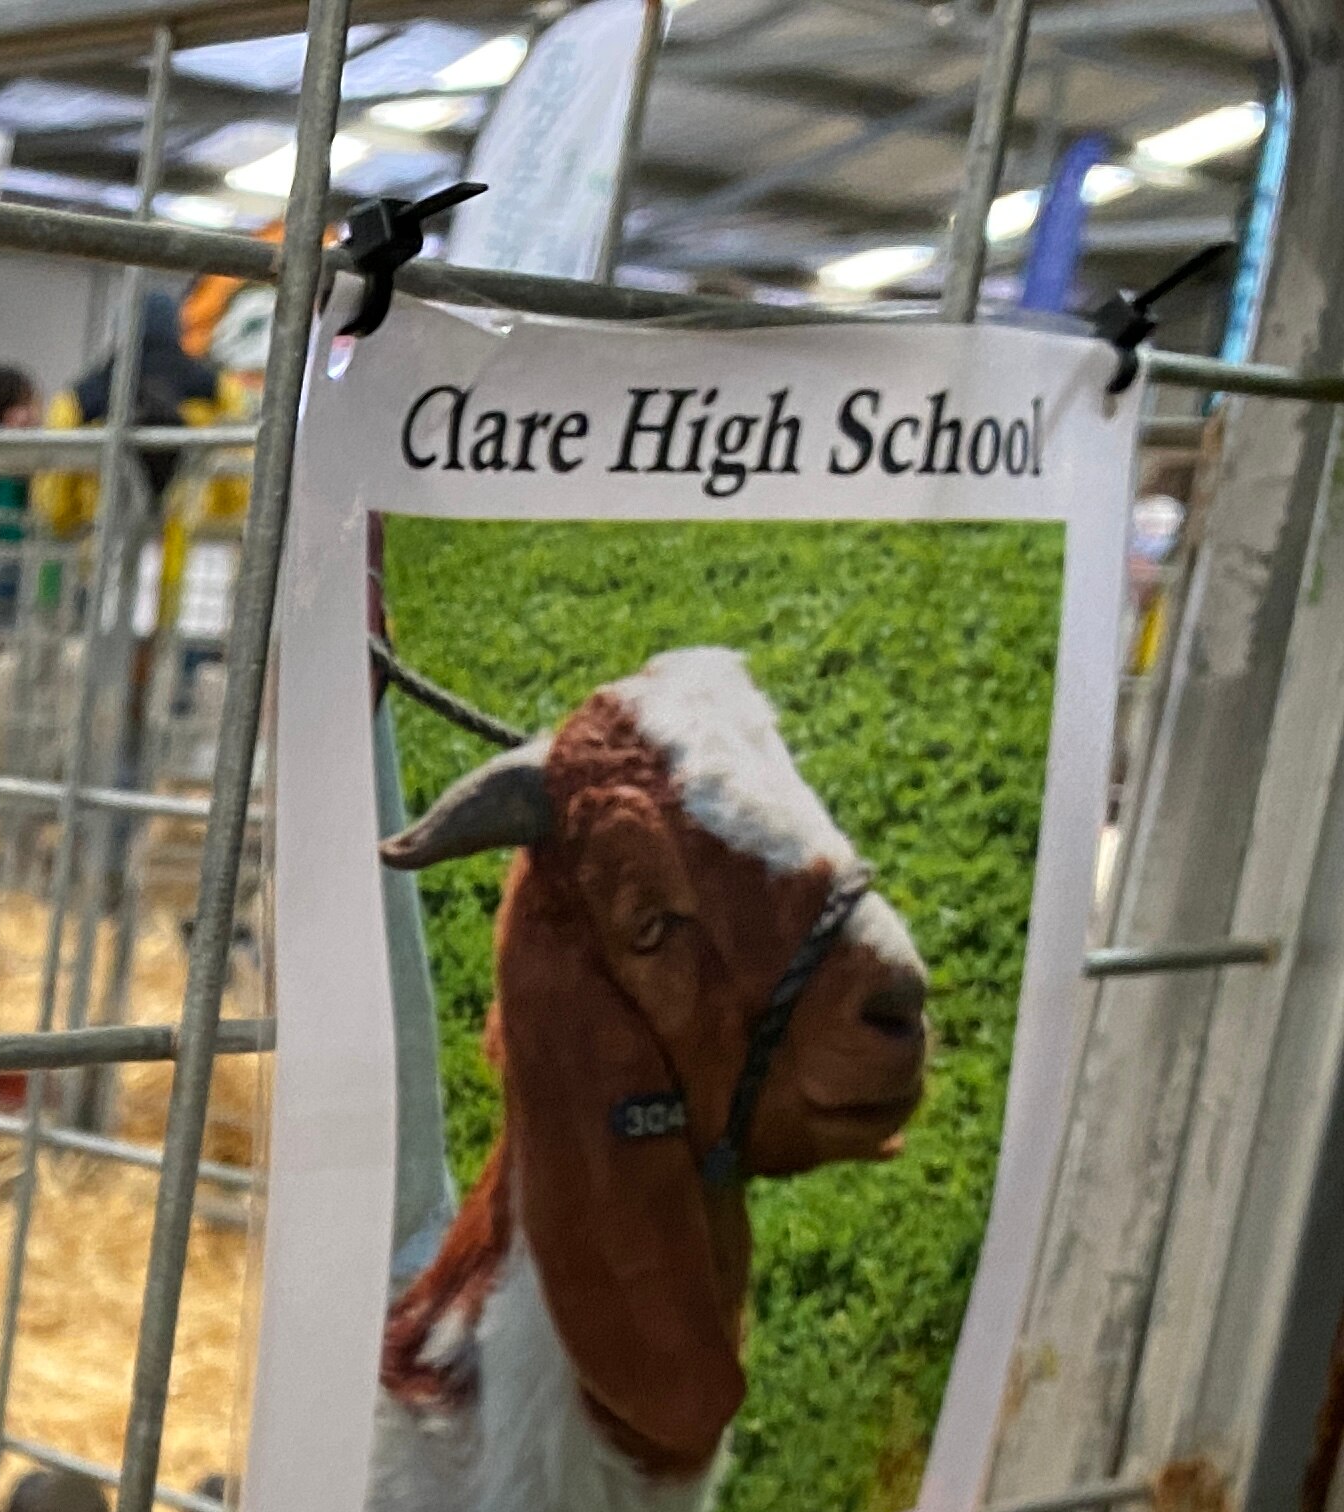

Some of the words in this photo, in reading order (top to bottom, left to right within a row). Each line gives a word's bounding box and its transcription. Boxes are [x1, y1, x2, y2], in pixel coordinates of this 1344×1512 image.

[401, 384, 590, 474] Clare
[608, 387, 802, 498] High
[828, 388, 1041, 476] School
